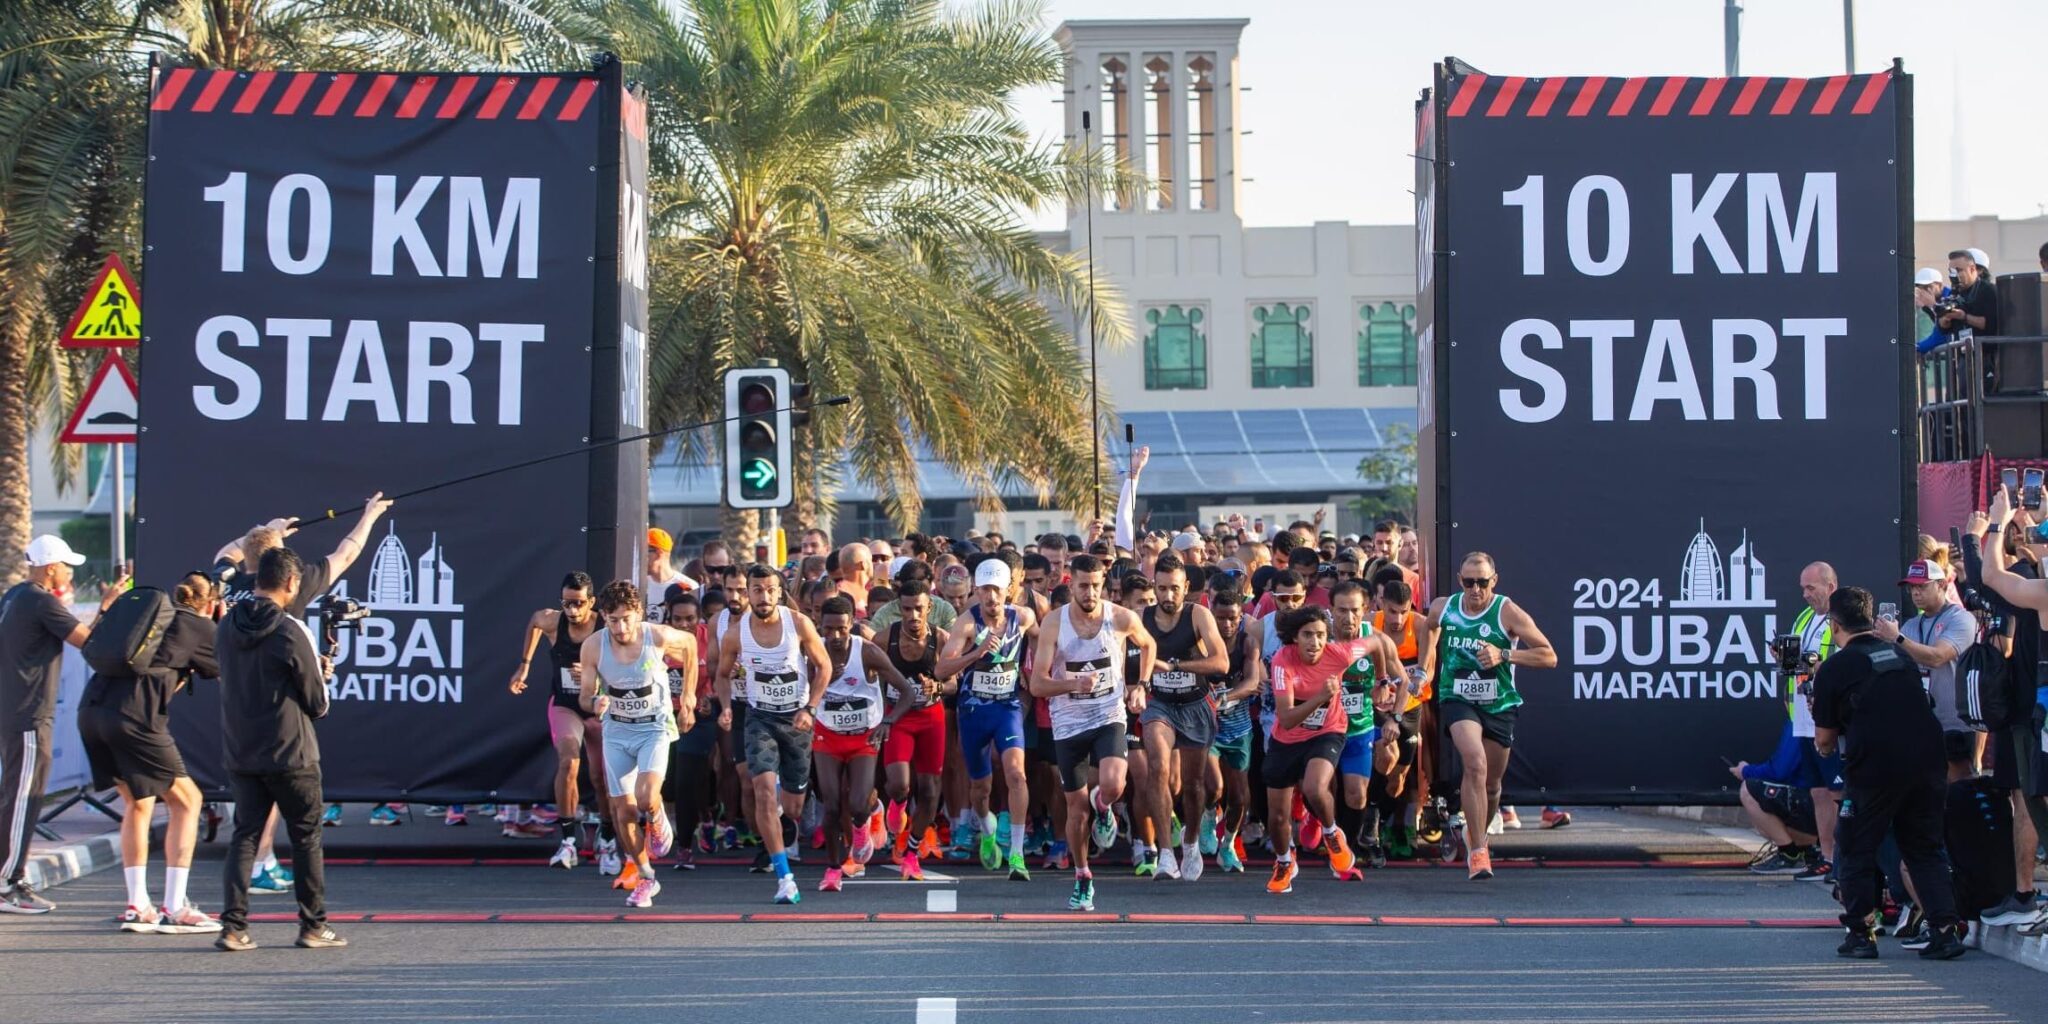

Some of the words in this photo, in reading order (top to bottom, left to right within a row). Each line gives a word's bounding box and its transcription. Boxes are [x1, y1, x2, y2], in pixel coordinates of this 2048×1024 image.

[204, 171, 332, 275] 10
[371, 174, 541, 279] KM
[1502, 174, 1630, 276] 10
[1671, 172, 1838, 274] KM
[192, 315, 545, 425] START
[1499, 318, 1847, 423] START
[1573, 578, 1663, 609] 2024
[306, 617, 464, 669] UBAI
[1573, 614, 1776, 666] DUBAI
[328, 673, 463, 703] RATHON
[762, 685, 794, 698] 13688
[980, 675, 1011, 686] 13405
[1459, 683, 1491, 694] 12887
[1574, 670, 1777, 699] MARATHON
[615, 699, 649, 711] 13500
[832, 713, 862, 726] 13691
